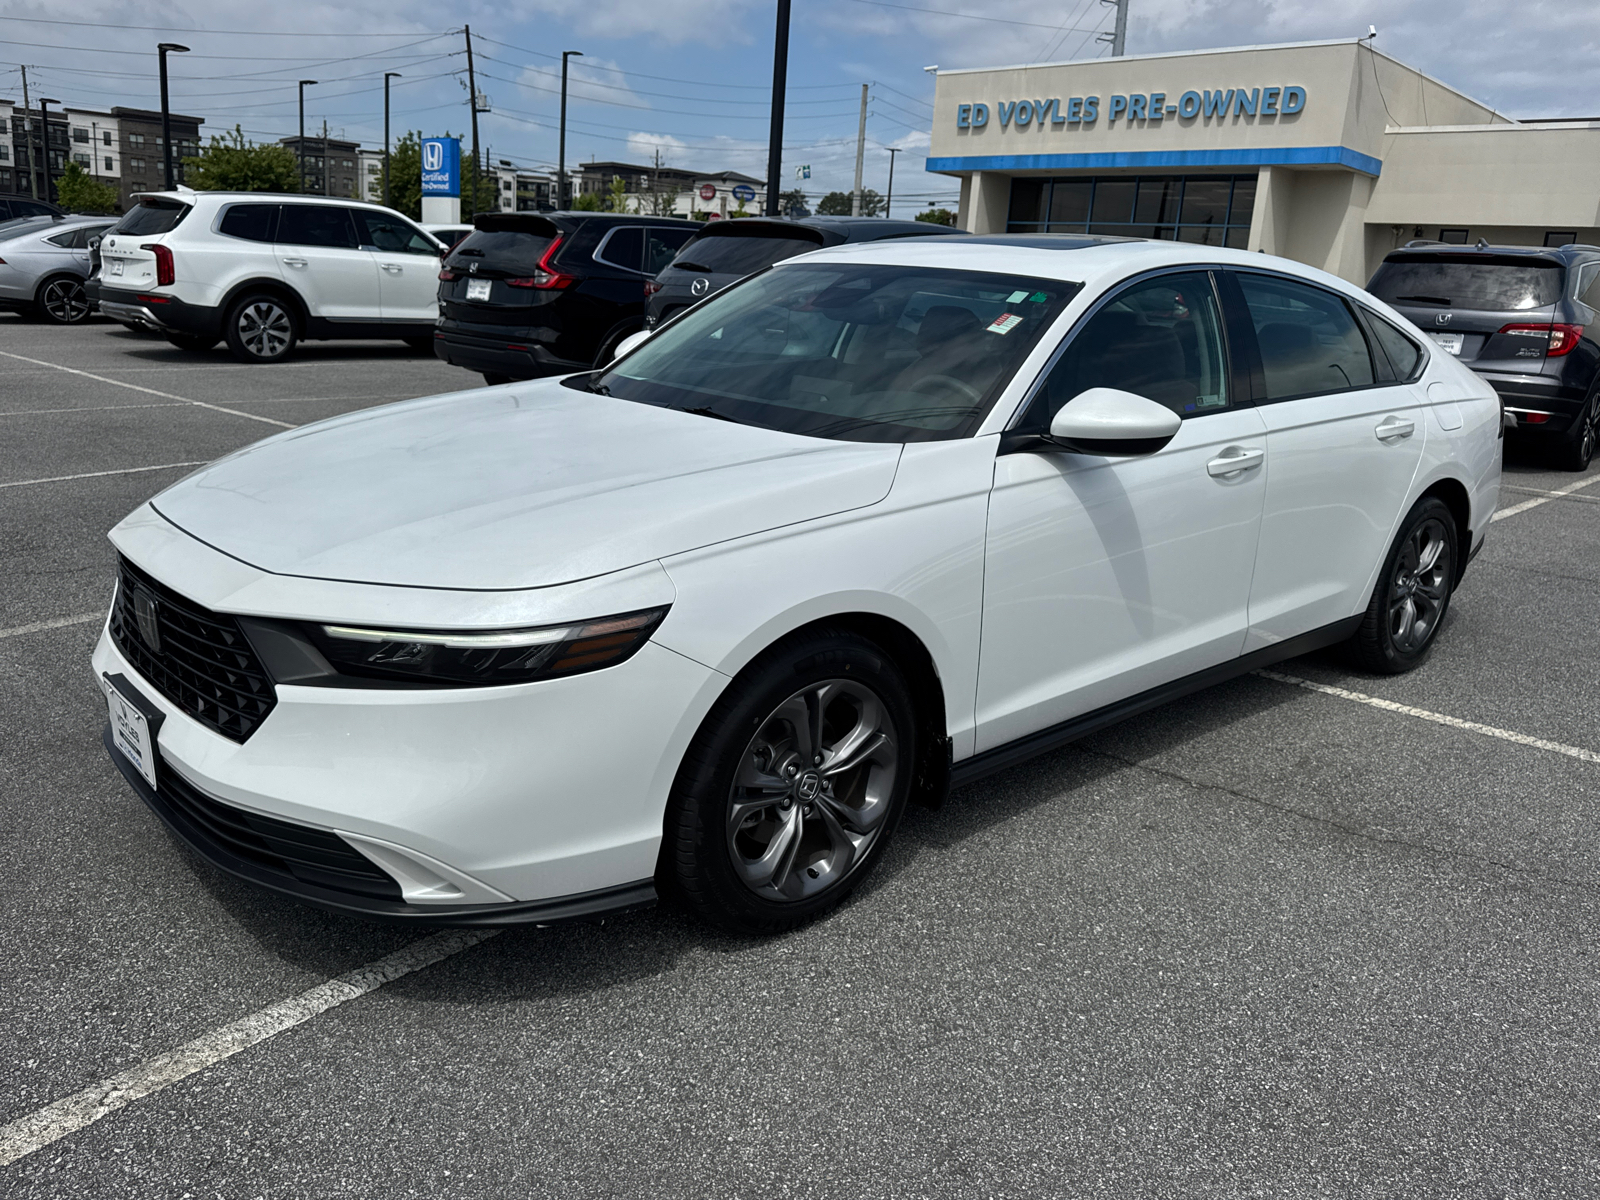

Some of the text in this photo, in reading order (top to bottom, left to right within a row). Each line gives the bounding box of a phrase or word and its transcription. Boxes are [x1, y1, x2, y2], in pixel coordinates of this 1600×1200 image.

[957, 85, 1307, 128] ED VOYLES PRE-OWNED
[421, 172, 449, 182] Certified
